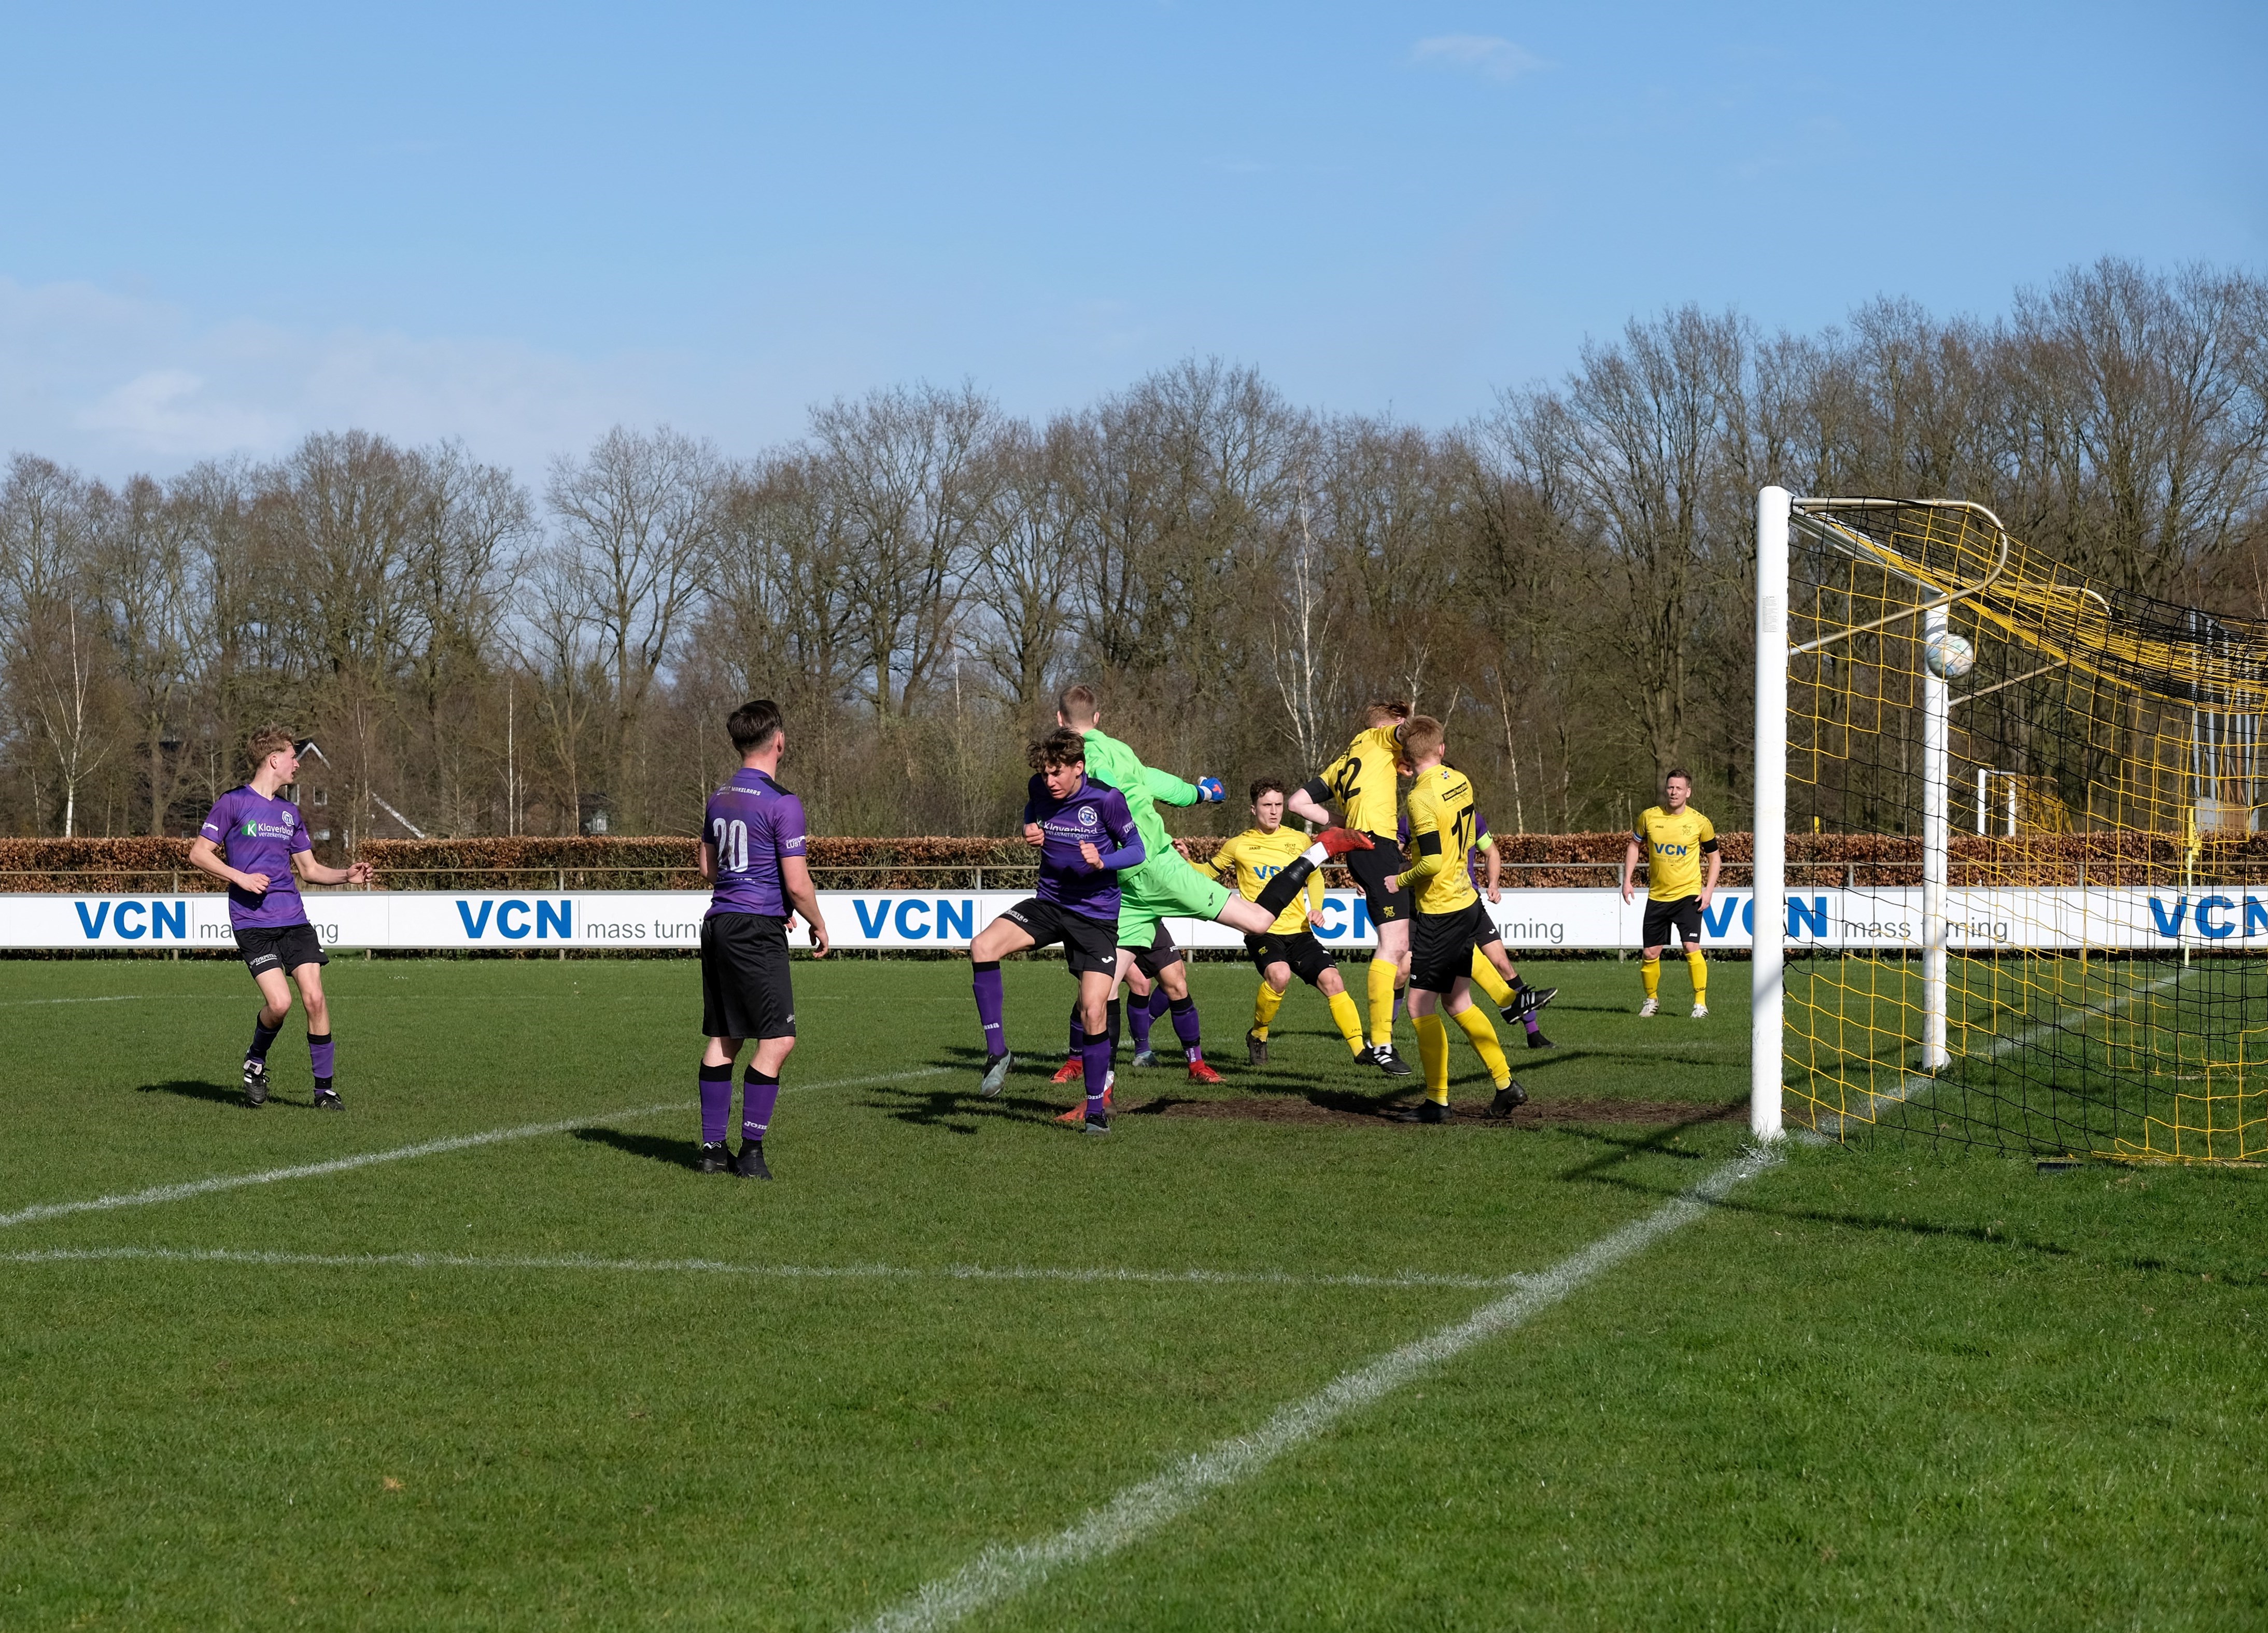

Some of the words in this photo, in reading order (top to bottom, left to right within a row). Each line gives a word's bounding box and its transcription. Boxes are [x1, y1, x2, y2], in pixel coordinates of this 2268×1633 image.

[258, 823, 293, 837] Klaverblad
[258, 832, 290, 841] verzekeringen
[713, 818, 748, 872] 20
[1452, 803, 1475, 860] 17
[1654, 842, 1687, 856] VCN
[1253, 866, 1288, 880] VC
[75, 901, 186, 939] VCN
[456, 900, 571, 939] VCN
[587, 923, 645, 938] mass
[654, 919, 702, 938] turni
[852, 899, 973, 939] VCN
[1309, 897, 1377, 939] CN
[1499, 918, 1563, 944] rning
[1702, 897, 1827, 937] VN
[1844, 922, 1911, 937] mass
[2148, 895, 2268, 939] VCN
